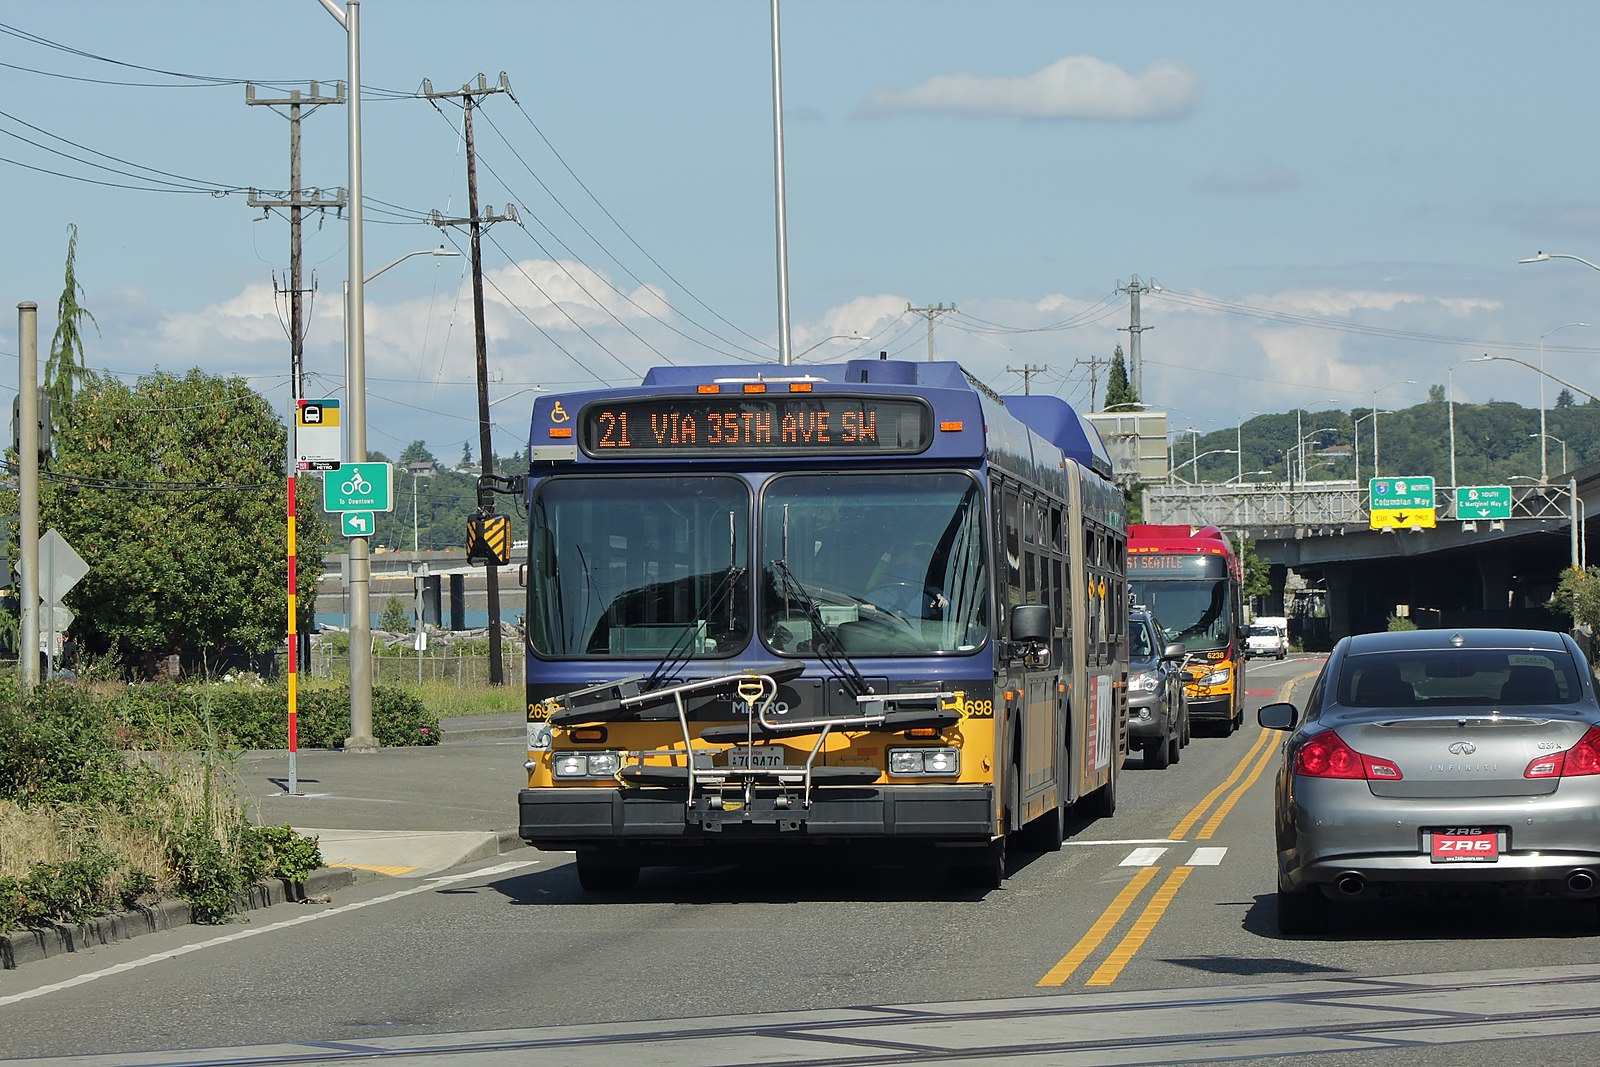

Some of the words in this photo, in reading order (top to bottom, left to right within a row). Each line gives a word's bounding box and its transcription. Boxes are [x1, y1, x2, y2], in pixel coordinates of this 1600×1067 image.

[599, 411, 631, 447] 21
[651, 413, 696, 444] VIA
[707, 412, 771, 443] 35TH
[782, 411, 830, 442] AVE
[841, 411, 875, 442] SW
[1374, 498, 1411, 506] Columbian
[1413, 497, 1430, 507] Way
[1141, 556, 1183, 569] SEATTLE
[732, 701, 789, 715] METRO
[1429, 764, 1498, 772] INFINITI
[1445, 828, 1482, 836] ZAG
[1438, 840, 1492, 851] ZAG
